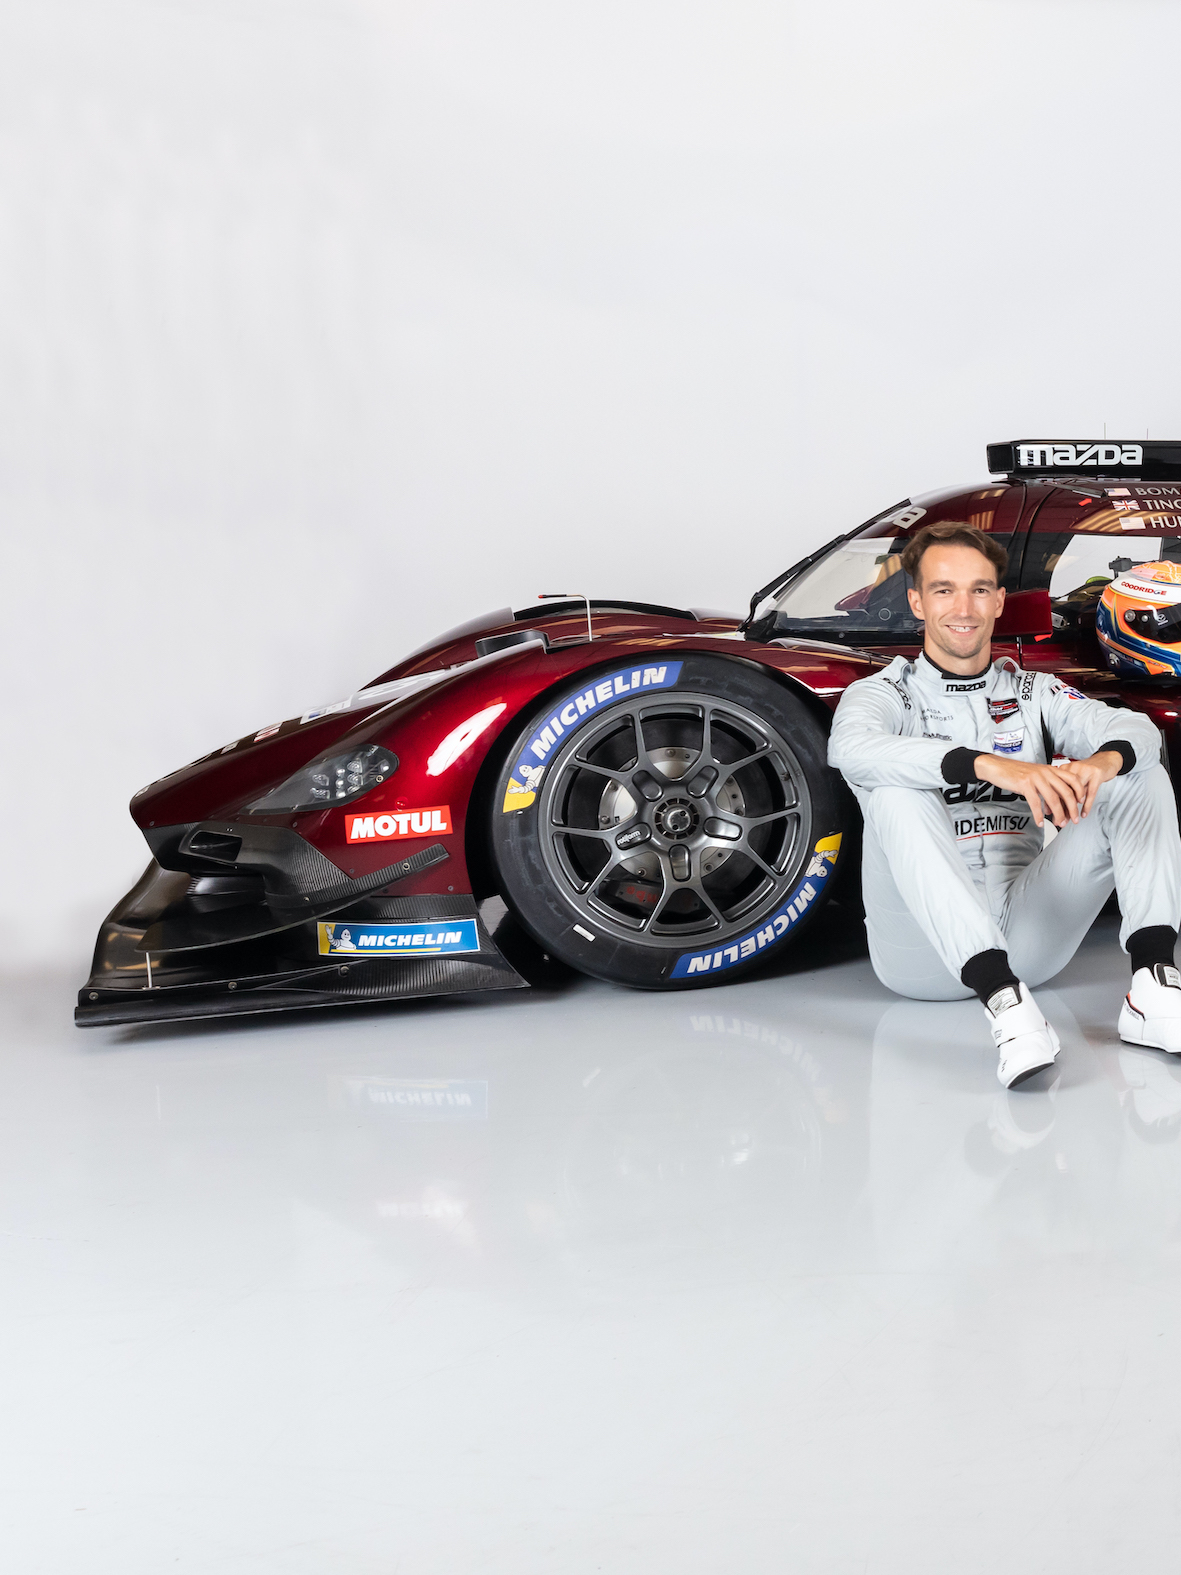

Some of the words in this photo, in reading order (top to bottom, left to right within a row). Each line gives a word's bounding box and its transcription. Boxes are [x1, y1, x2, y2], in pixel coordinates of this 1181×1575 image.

[1120, 581, 1168, 596] GOODRIDGE
[530, 665, 668, 761] MICHELIN
[350, 809, 448, 840] MOTUL
[954, 815, 1030, 836] IDEMITSU
[358, 931, 463, 947] MICHELIN
[687, 882, 818, 974] MICHELIN
